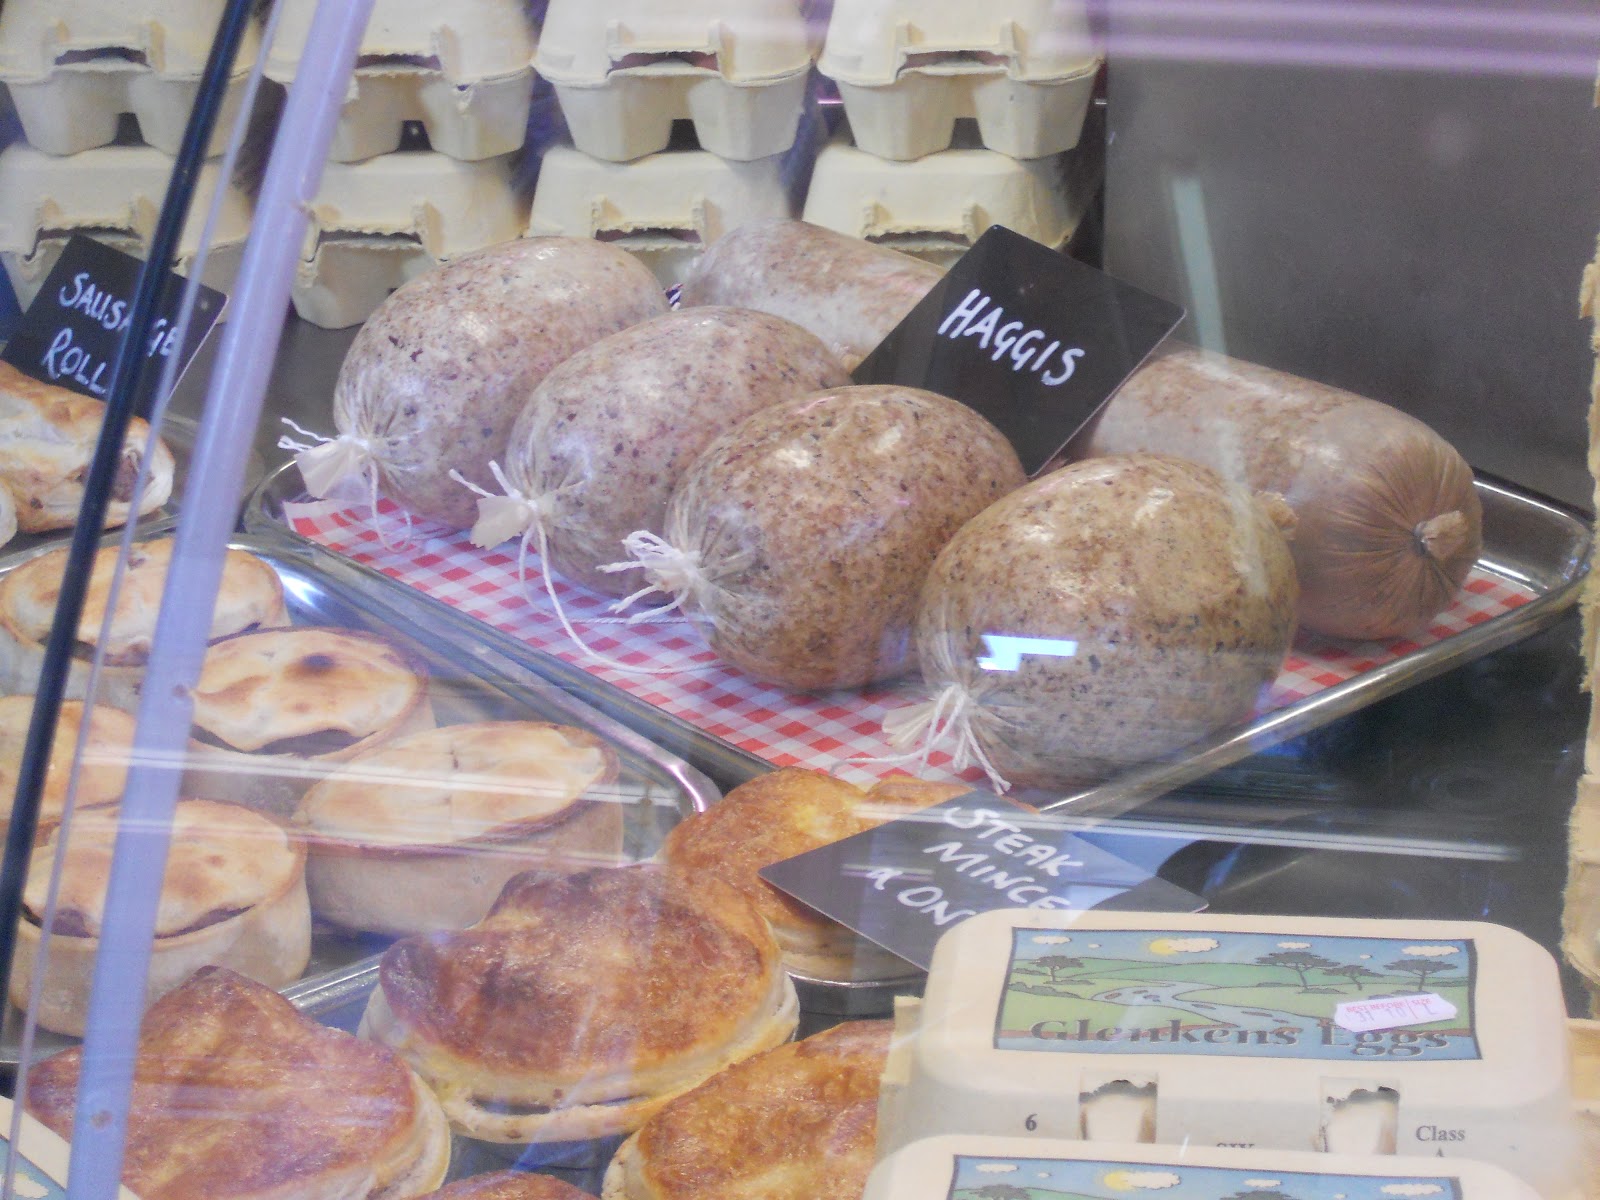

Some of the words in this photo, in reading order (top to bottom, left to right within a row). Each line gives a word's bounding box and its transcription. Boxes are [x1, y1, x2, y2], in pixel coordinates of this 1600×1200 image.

[936, 288, 1086, 387] HAGGIS
[943, 806, 1085, 877] STEAK
[922, 841, 1073, 910] MINCE
[1030, 1018, 1303, 1046] Glenkens
[1317, 1018, 1450, 1058] Eggs
[1025, 1113, 1038, 1132] 6
[1415, 1125, 1466, 1142] Class
